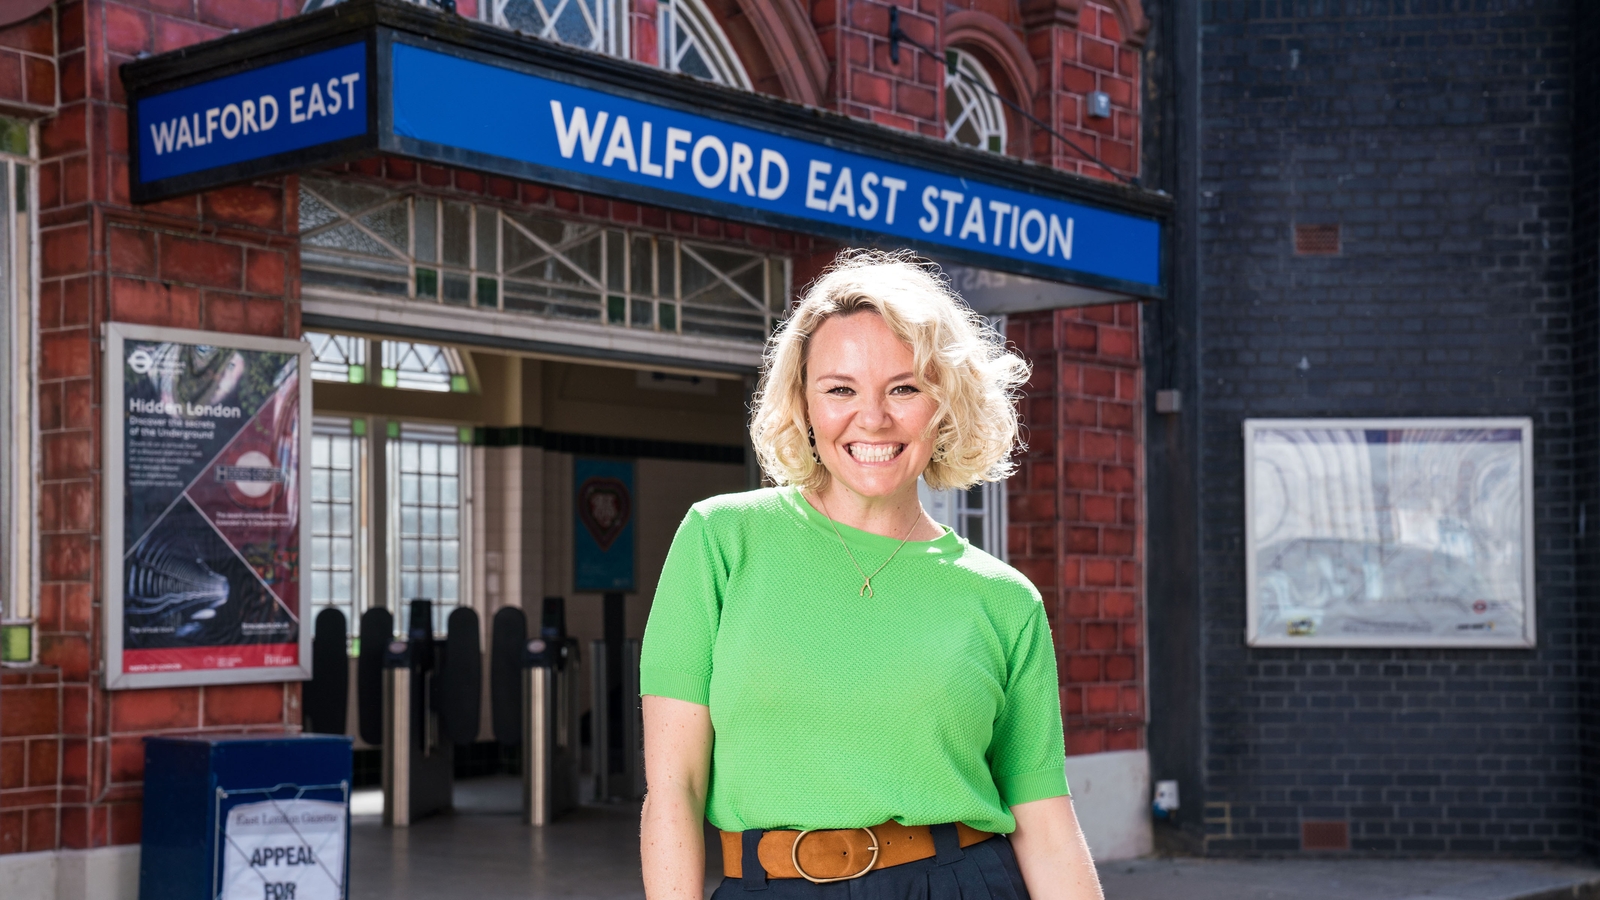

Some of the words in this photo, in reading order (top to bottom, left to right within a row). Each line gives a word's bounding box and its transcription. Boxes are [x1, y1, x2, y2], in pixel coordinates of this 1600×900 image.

[150, 94, 279, 156] WALFORD
[290, 72, 360, 124] EAST
[550, 99, 789, 201] WALFORD
[805, 159, 906, 225] EAST
[919, 185, 1074, 260] STATION
[129, 398, 183, 415] Hidden
[186, 401, 241, 418] London
[129, 415, 166, 427] Discover
[185, 420, 216, 430] secrets
[129, 427, 139, 436] of
[157, 429, 214, 440] Underground
[236, 813, 259, 826] East
[250, 845, 316, 868] APPEAL
[264, 881, 297, 900] FOR
